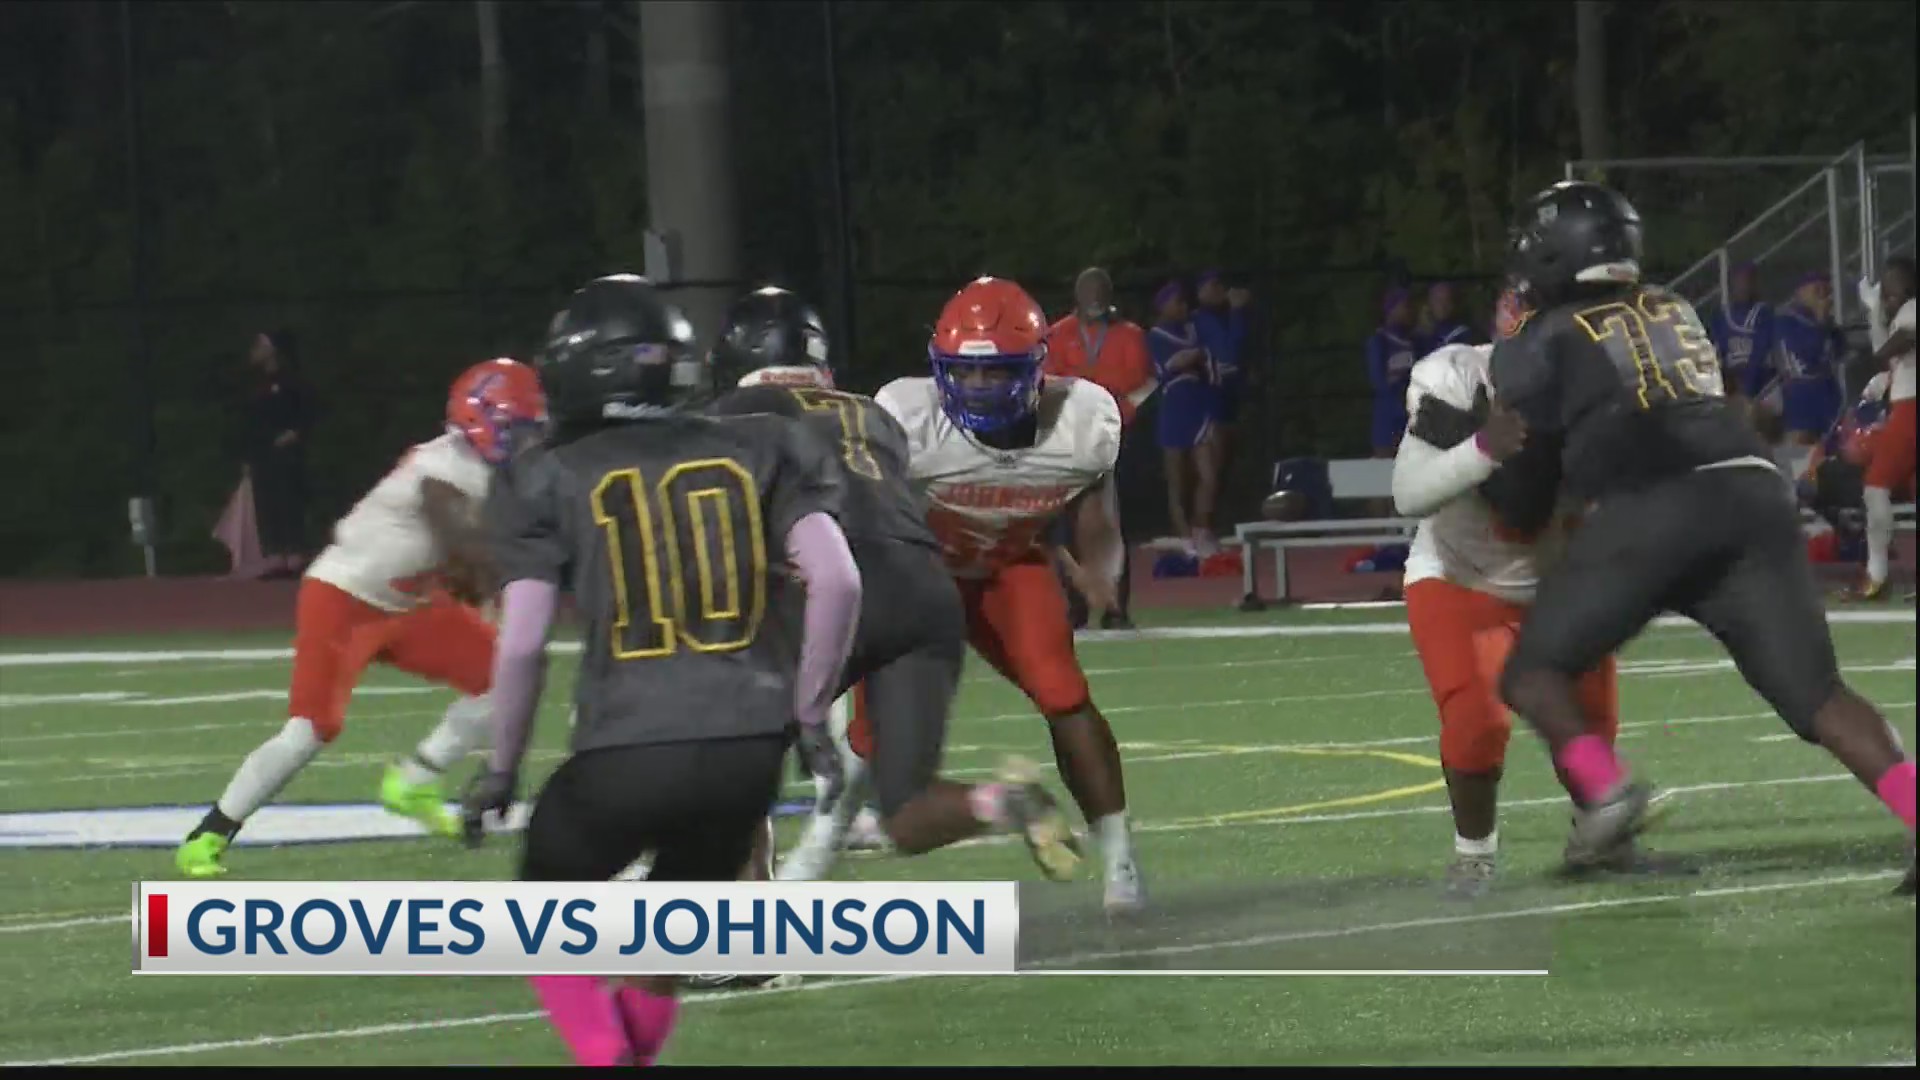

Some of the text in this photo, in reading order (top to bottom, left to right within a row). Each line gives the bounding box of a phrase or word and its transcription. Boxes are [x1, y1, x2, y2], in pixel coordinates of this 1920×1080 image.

[1572, 284, 1725, 410] 73
[786, 385, 884, 481] 7
[589, 456, 768, 660] 10
